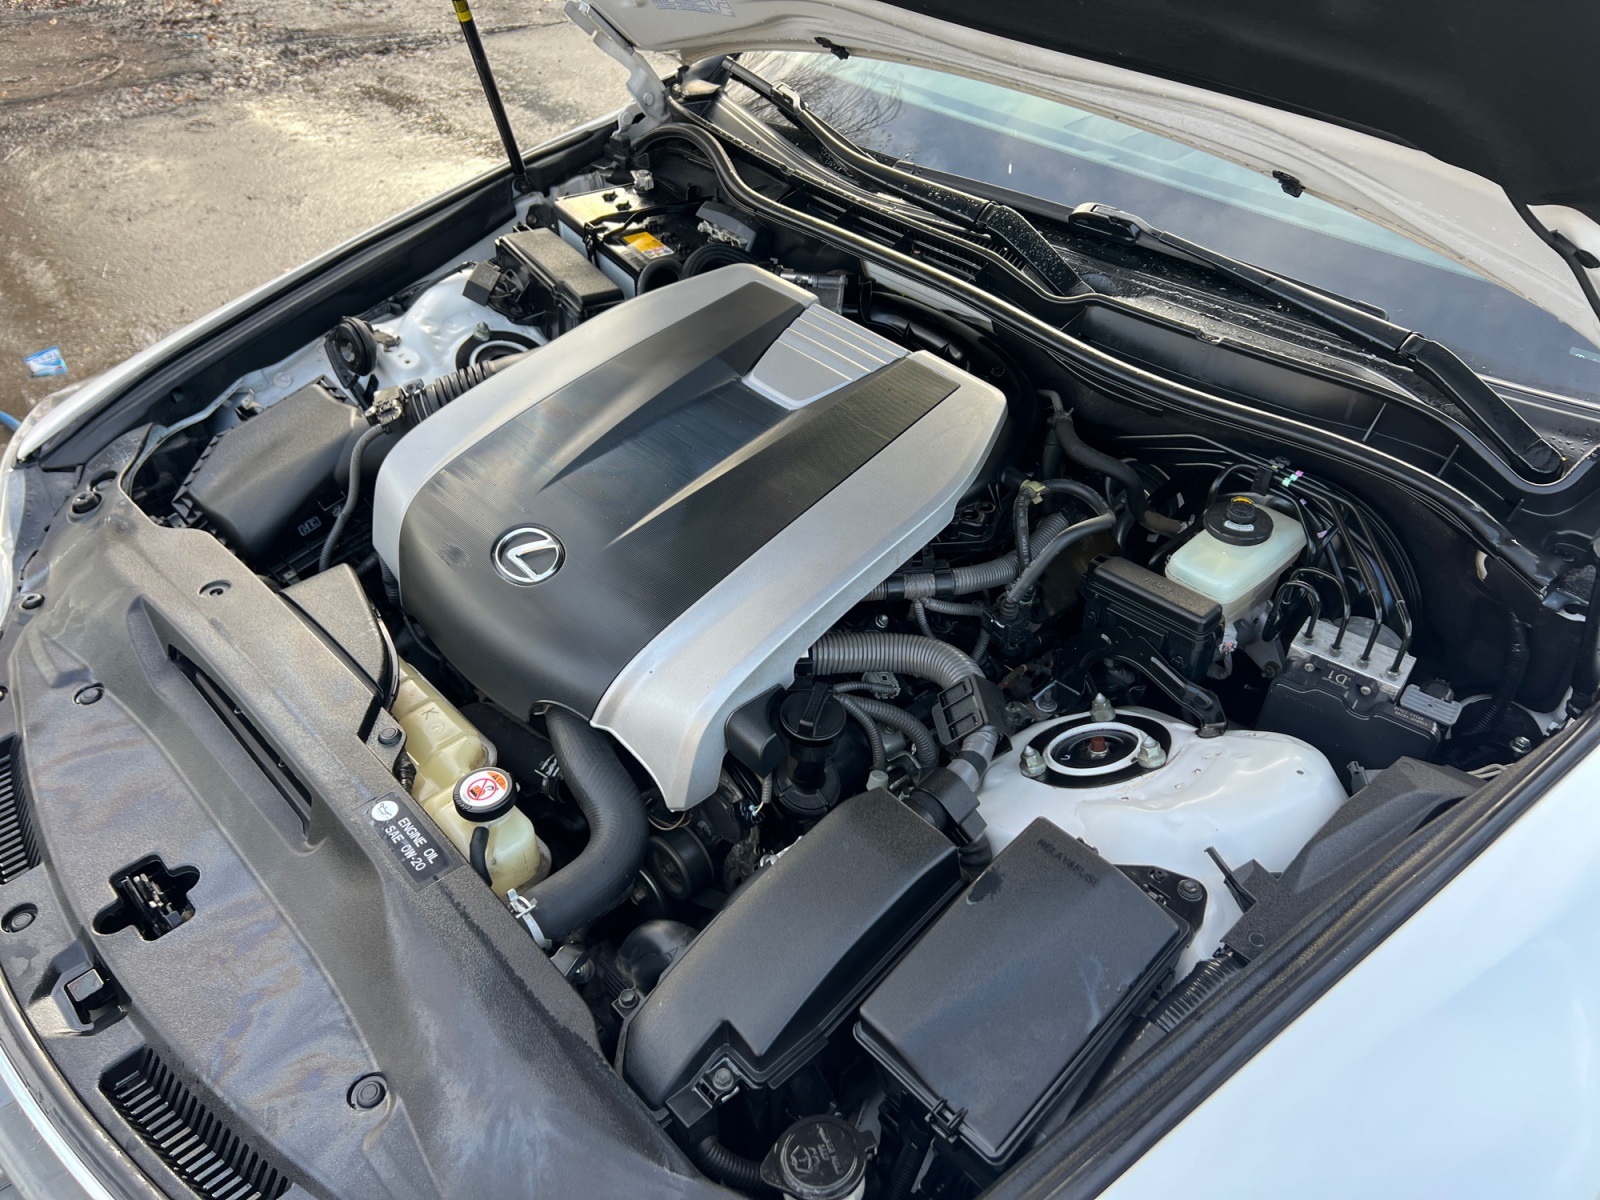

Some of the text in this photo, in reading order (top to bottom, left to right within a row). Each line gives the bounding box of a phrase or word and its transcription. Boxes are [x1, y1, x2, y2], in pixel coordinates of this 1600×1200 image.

[385, 825, 426, 871] SAE 0W-20
[397, 817, 439, 865] ENGINE OIL
